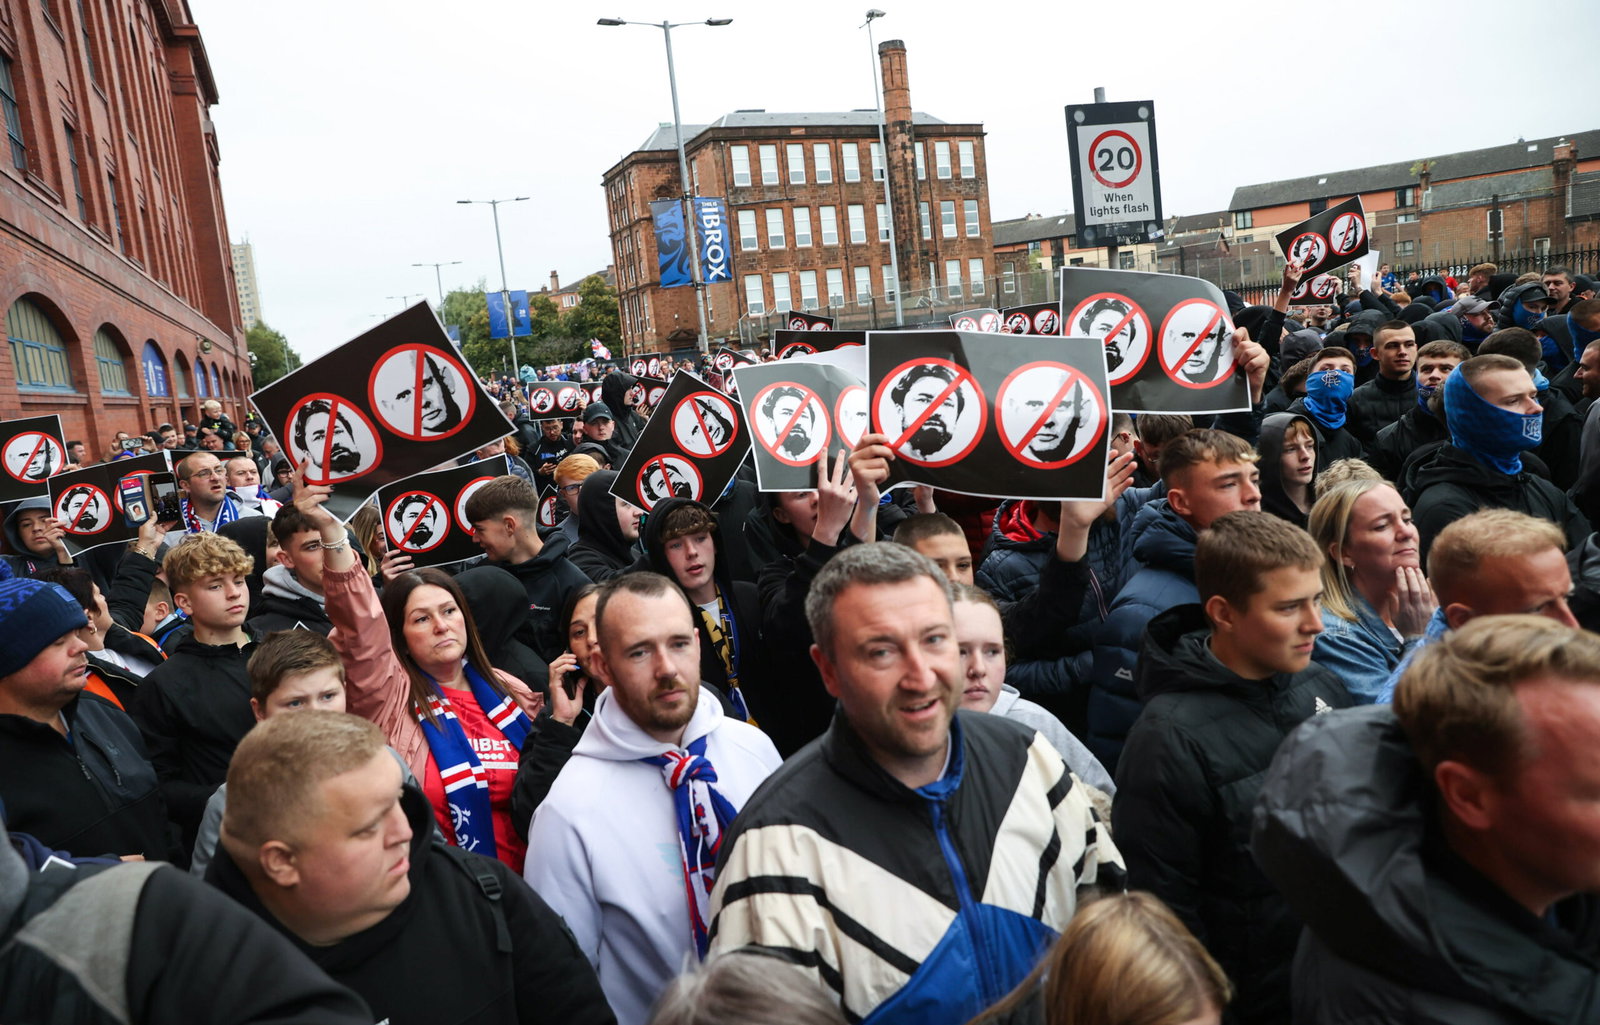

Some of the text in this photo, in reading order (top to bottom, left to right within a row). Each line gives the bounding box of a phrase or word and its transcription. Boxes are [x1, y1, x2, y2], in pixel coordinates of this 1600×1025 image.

[1098, 147, 1135, 171] 20
[1104, 193, 1134, 203] When
[1090, 203, 1149, 217] lights flash
[702, 207, 725, 280] IBROX
